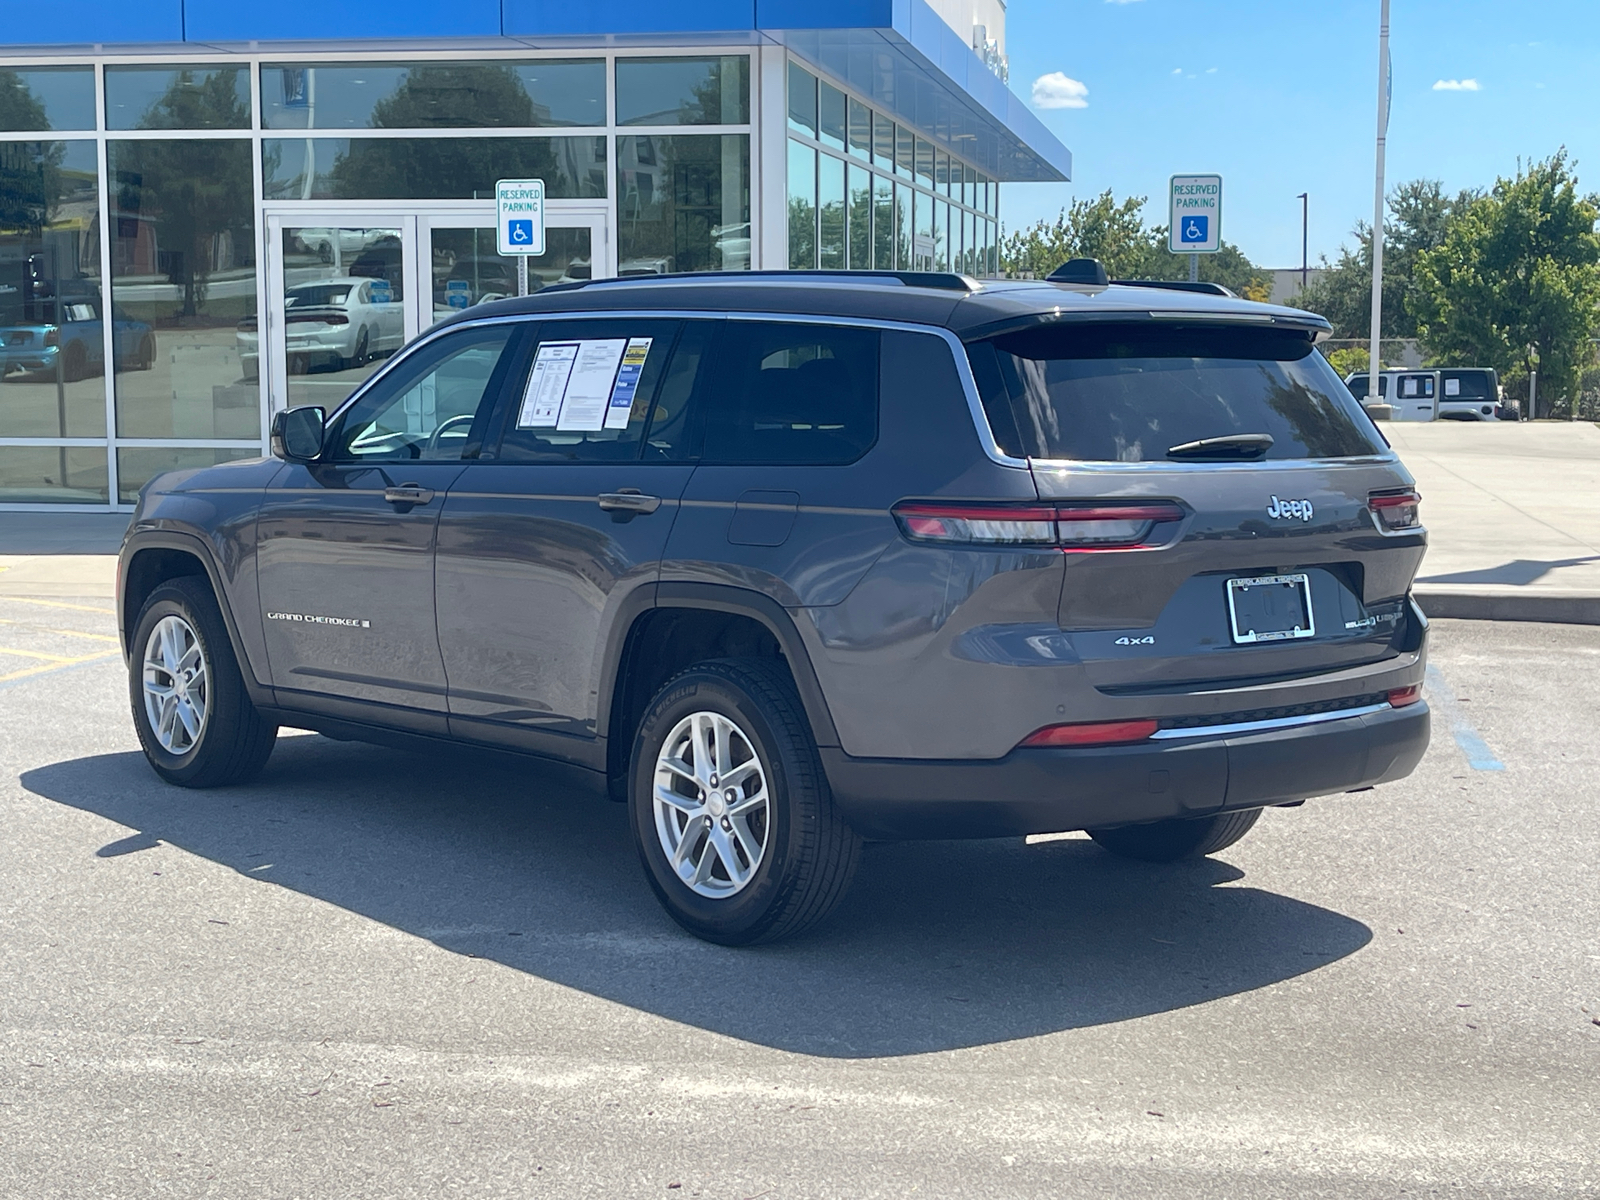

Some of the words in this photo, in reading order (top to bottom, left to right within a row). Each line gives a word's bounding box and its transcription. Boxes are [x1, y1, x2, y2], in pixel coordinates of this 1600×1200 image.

[500, 189, 540, 199] RESERVED
[1174, 184, 1218, 195] RESERVED
[502, 202, 538, 212] PARKING
[1176, 198, 1215, 208] PARKING
[1266, 494, 1314, 522] Jeep
[267, 612, 303, 621] GRAND
[304, 615, 361, 627] CHEROKEE
[1114, 635, 1156, 646] 4x4
[656, 684, 697, 714] MICHELIN
